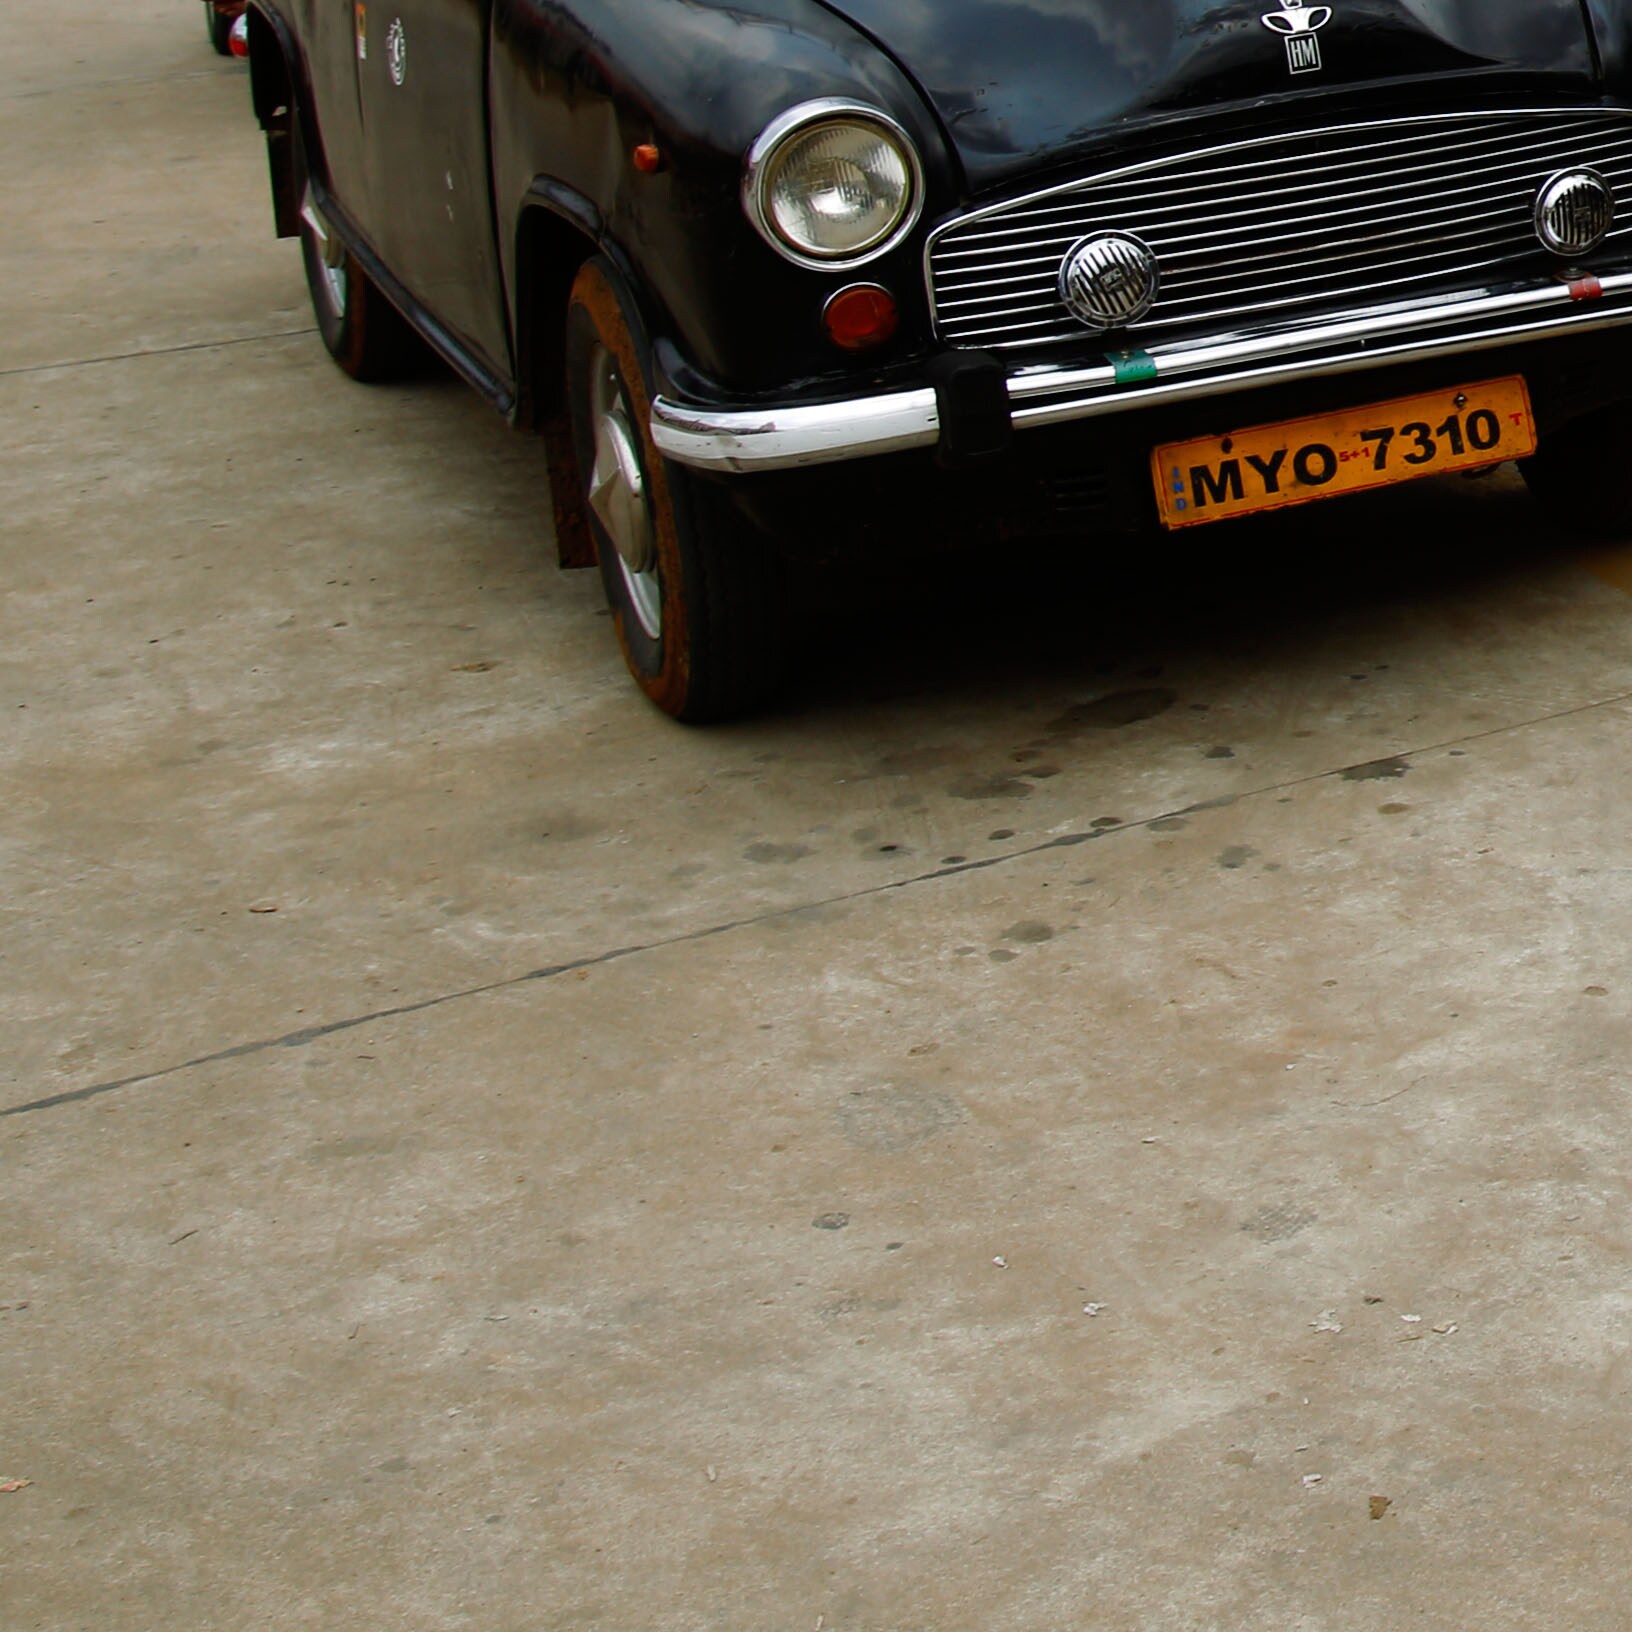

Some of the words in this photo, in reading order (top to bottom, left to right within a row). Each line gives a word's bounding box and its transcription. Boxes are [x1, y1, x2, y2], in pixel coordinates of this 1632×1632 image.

[1290, 38, 1317, 68] HM
[1188, 442, 1339, 508] MYO
[1361, 407, 1501, 472] 7310
